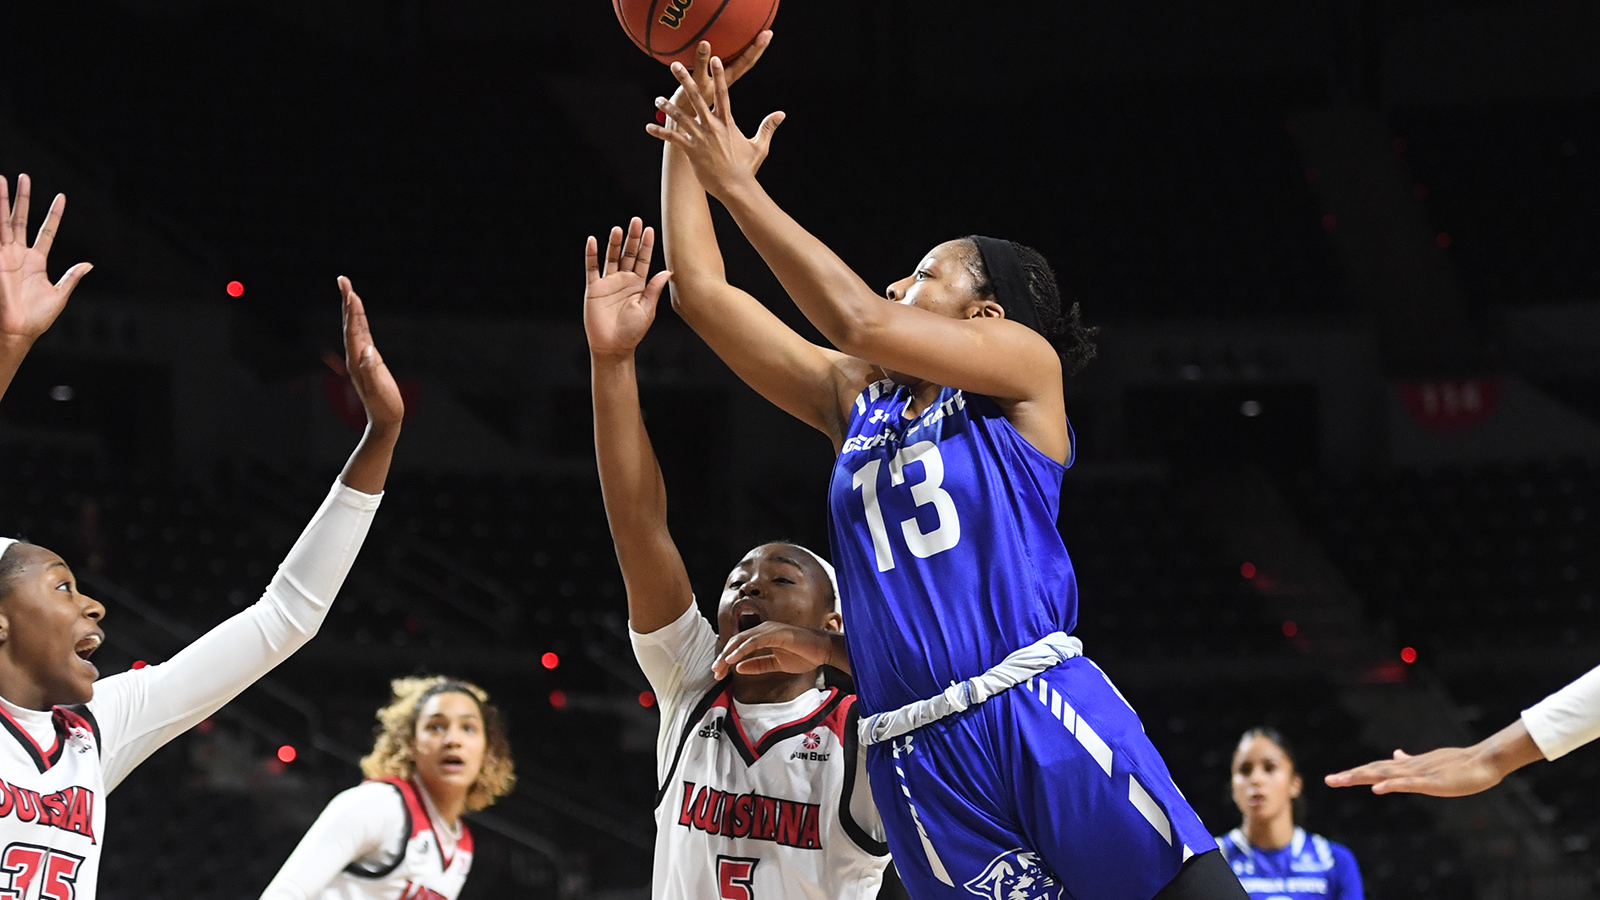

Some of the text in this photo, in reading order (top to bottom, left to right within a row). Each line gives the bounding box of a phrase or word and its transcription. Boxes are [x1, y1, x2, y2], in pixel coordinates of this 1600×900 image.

[852, 440, 961, 573] 13
[678, 780, 823, 850] LOUISIANA
[0, 841, 86, 900] 35
[716, 854, 760, 900] 5
